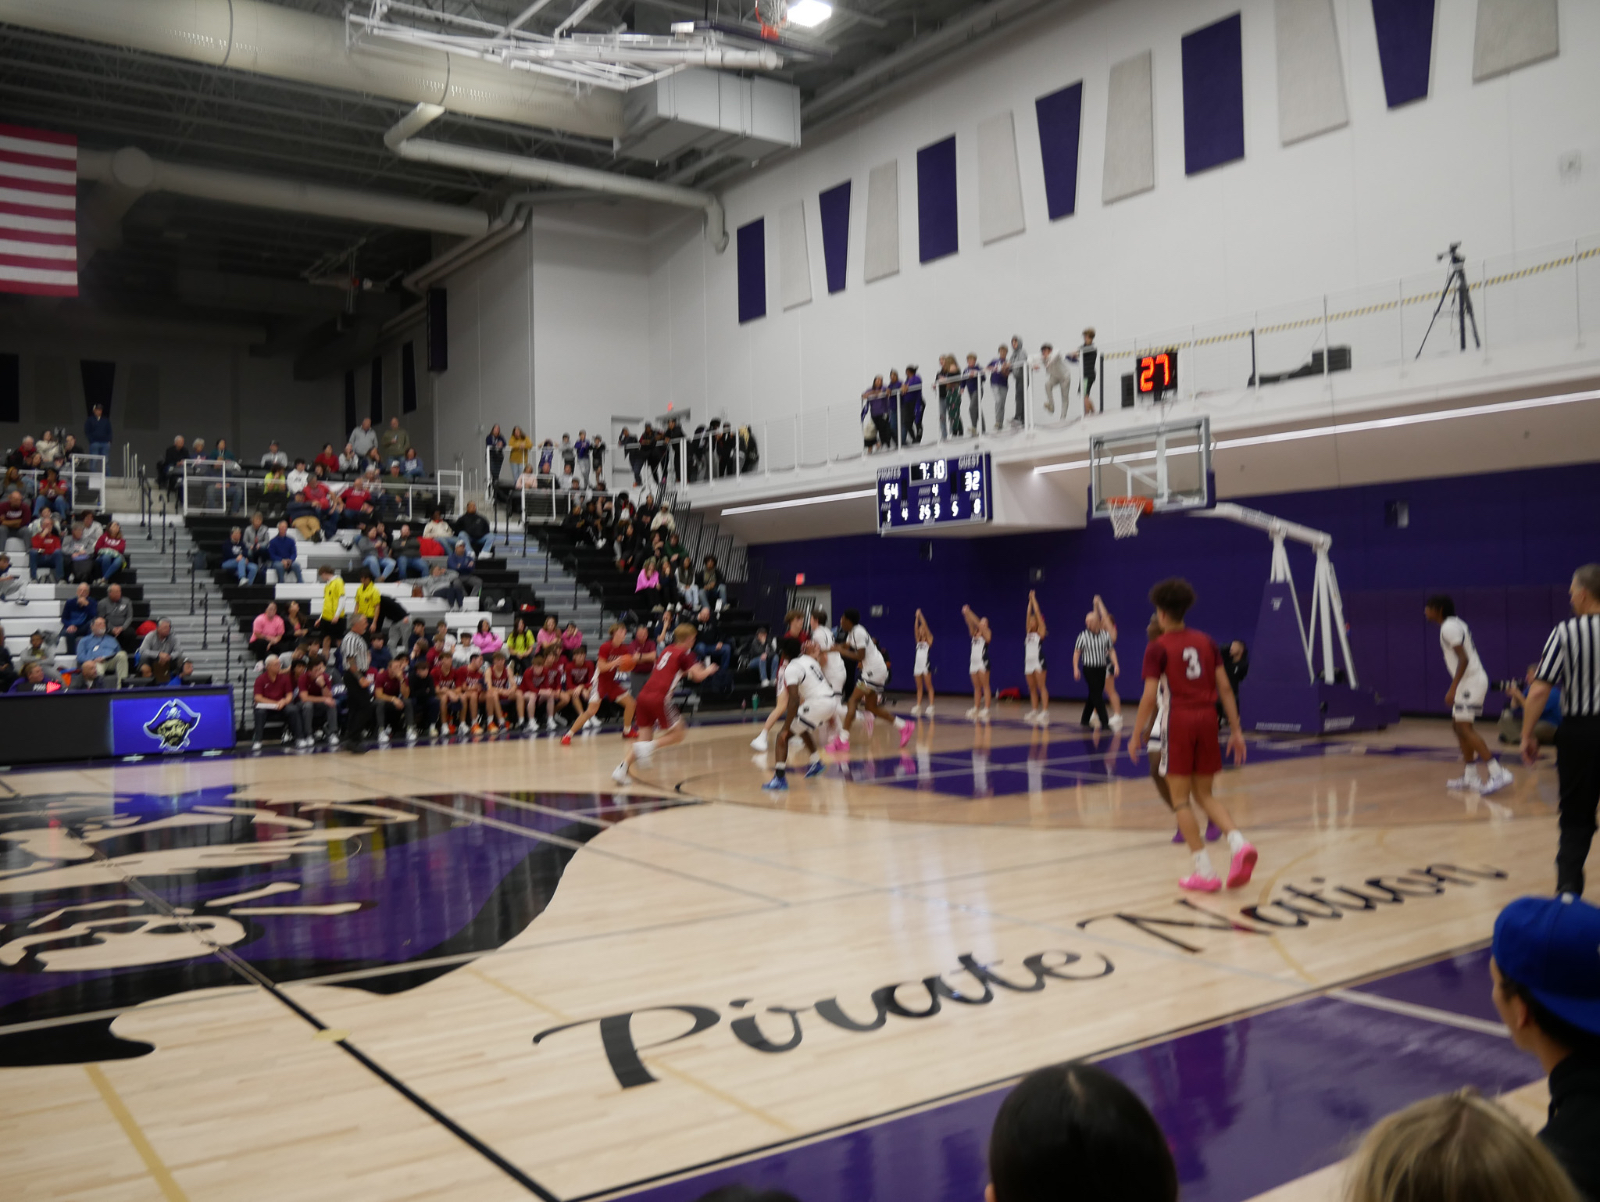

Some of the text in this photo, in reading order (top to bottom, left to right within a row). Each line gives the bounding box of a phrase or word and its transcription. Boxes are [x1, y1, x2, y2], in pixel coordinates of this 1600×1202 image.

[1140, 353, 1169, 392] 27
[919, 459, 945, 480] 7:10
[958, 455, 980, 470] GUEST
[964, 470, 981, 491] 32
[883, 483, 899, 502] 54
[1182, 646, 1202, 680] 3
[532, 864, 1508, 1090] Pirate Nation
